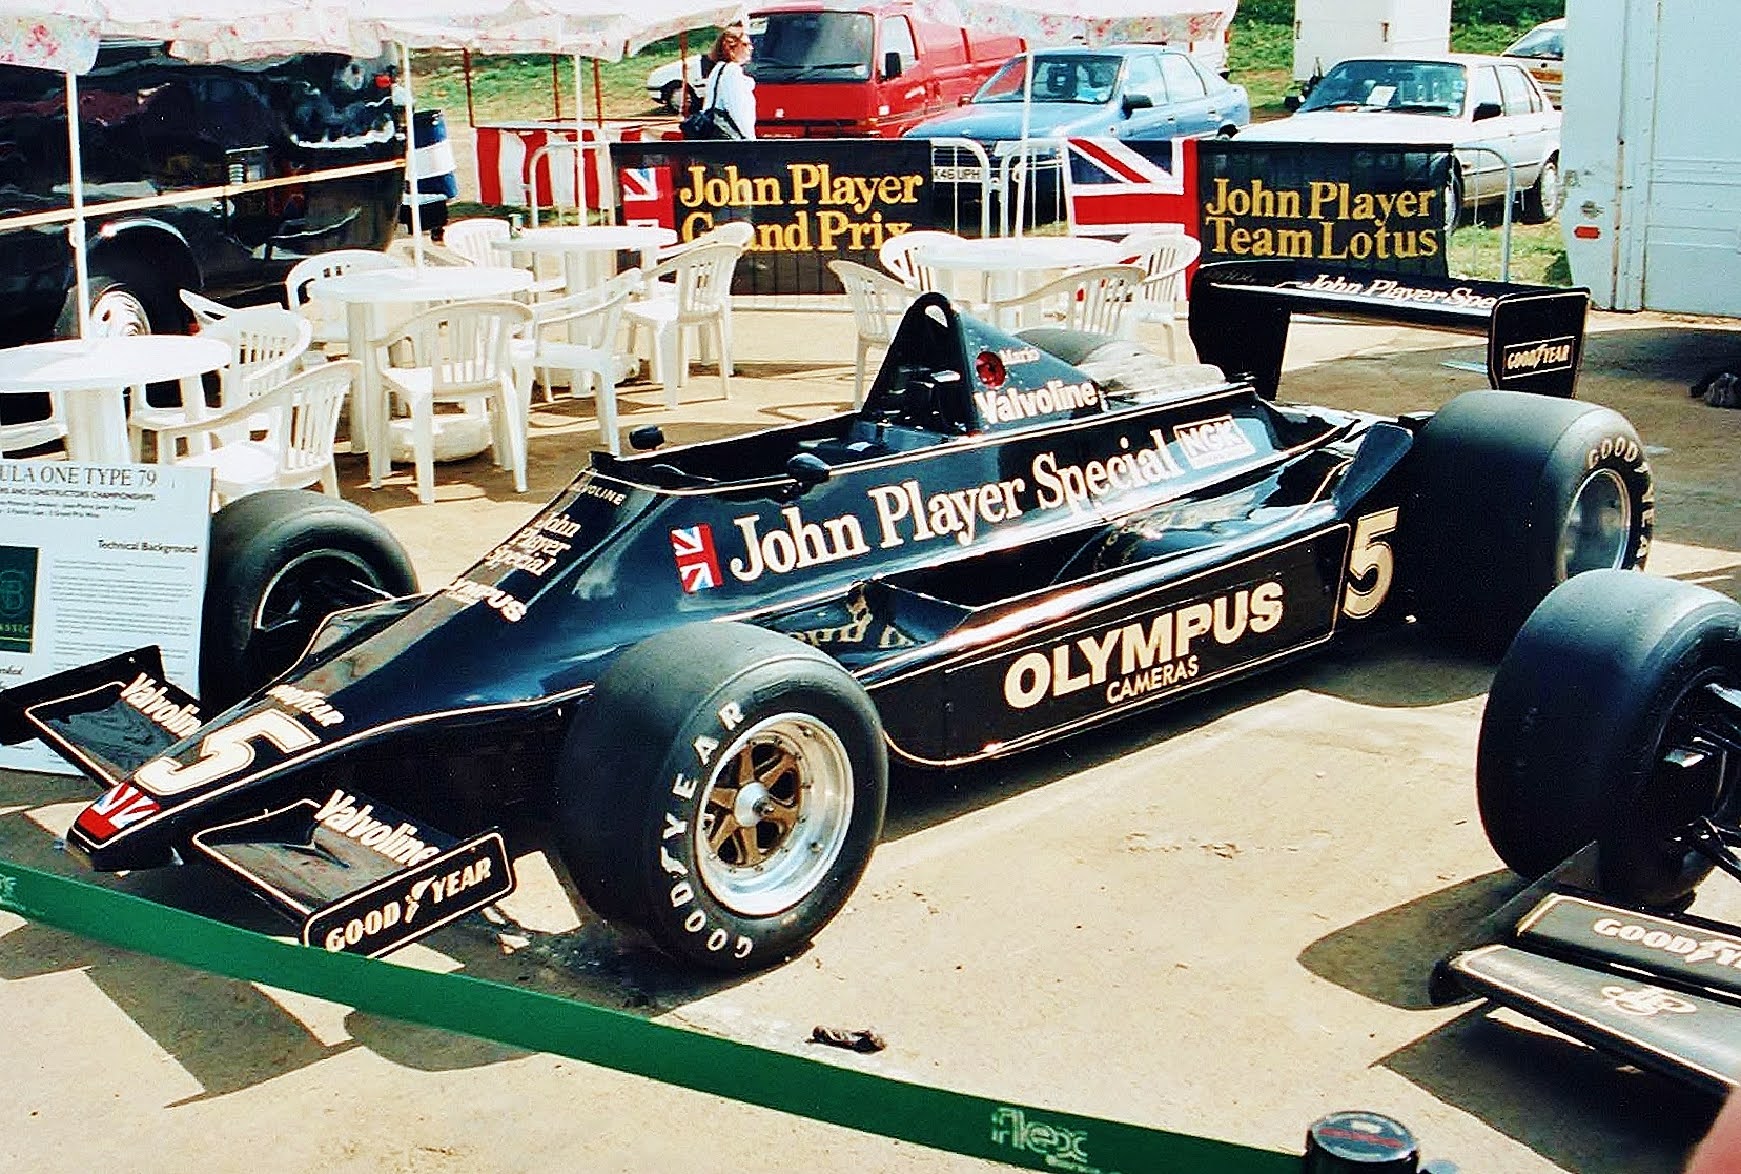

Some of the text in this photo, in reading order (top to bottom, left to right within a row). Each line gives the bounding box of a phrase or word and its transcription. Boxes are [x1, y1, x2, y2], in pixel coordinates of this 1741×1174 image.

[679, 163, 923, 213] John Player
[1205, 178, 1436, 228] John Player
[681, 210, 813, 252] Gnd
[1205, 215, 1440, 259] Team Lotus
[1301, 274, 1363, 295] John
[1362, 279, 1448, 304] Player
[973, 379, 1099, 424] Valvoline
[40, 466, 80, 485] ONE
[84, 468, 133, 487] TYPE
[138, 469, 158, 488] 79
[1588, 436, 1640, 469] GOOD
[730, 429, 1187, 582] John Player Special
[98, 538, 198, 555] Technical Background
[1341, 506, 1399, 620] 5
[1004, 581, 1285, 710] OLYMPUS
[120, 671, 202, 739] Valvolin
[1105, 654, 1200, 706] CAMERAS
[134, 708, 321, 797] 5
[313, 788, 445, 868] Valvoline
